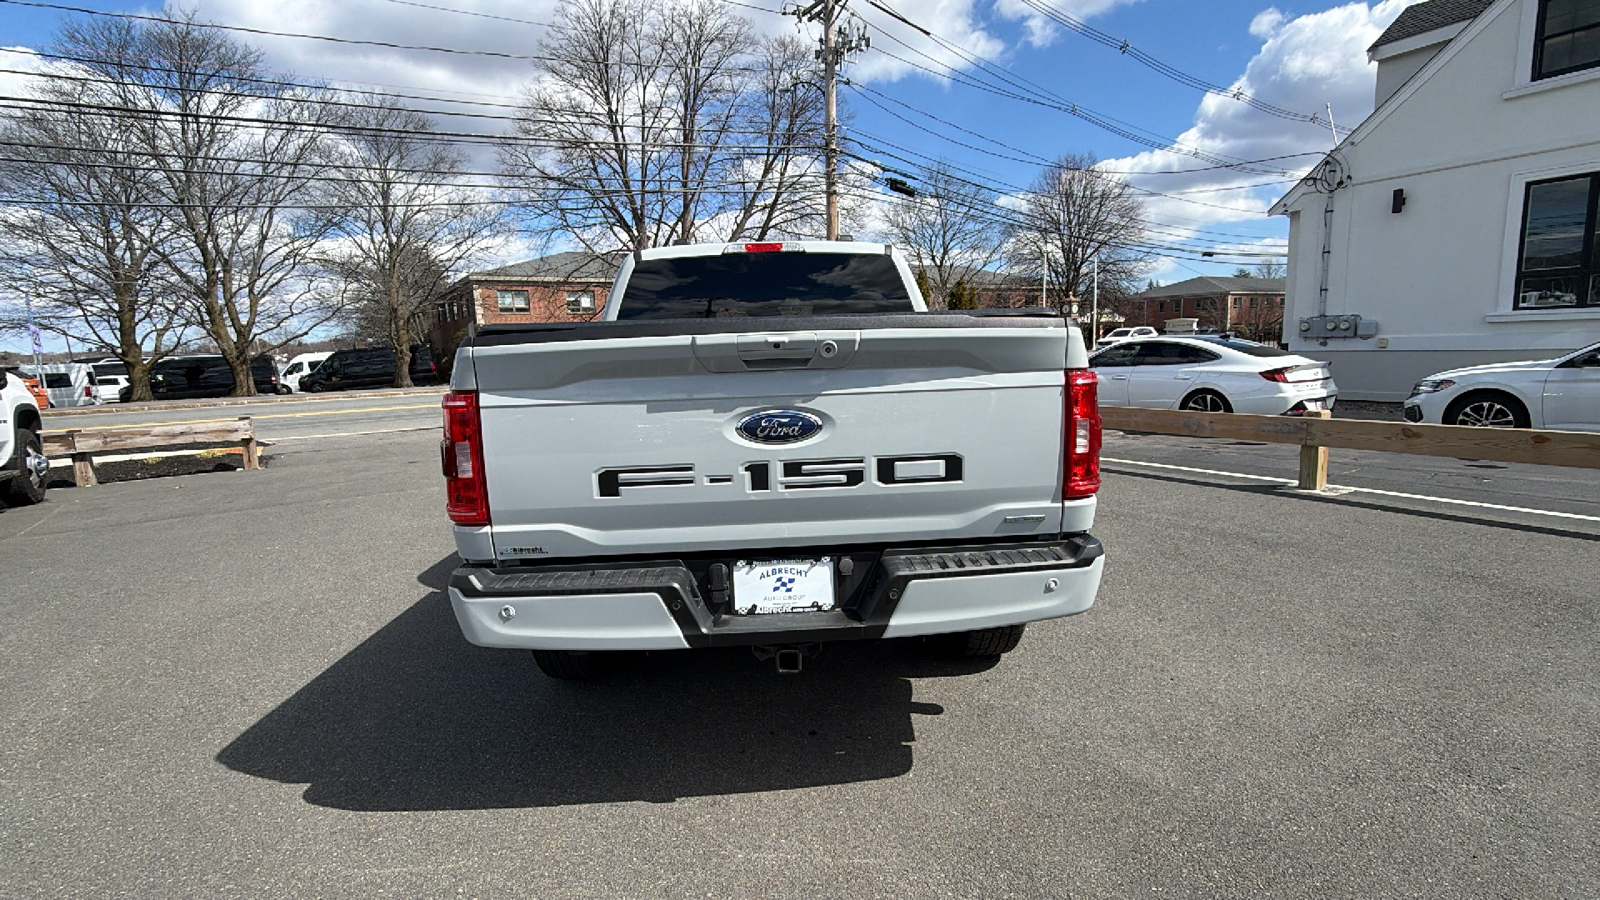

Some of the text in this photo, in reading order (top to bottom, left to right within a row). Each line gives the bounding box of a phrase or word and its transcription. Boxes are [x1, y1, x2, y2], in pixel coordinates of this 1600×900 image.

[756, 417, 803, 437] Ford
[592, 452, 965, 500] F-150
[759, 567, 809, 580] ALBRECHT
